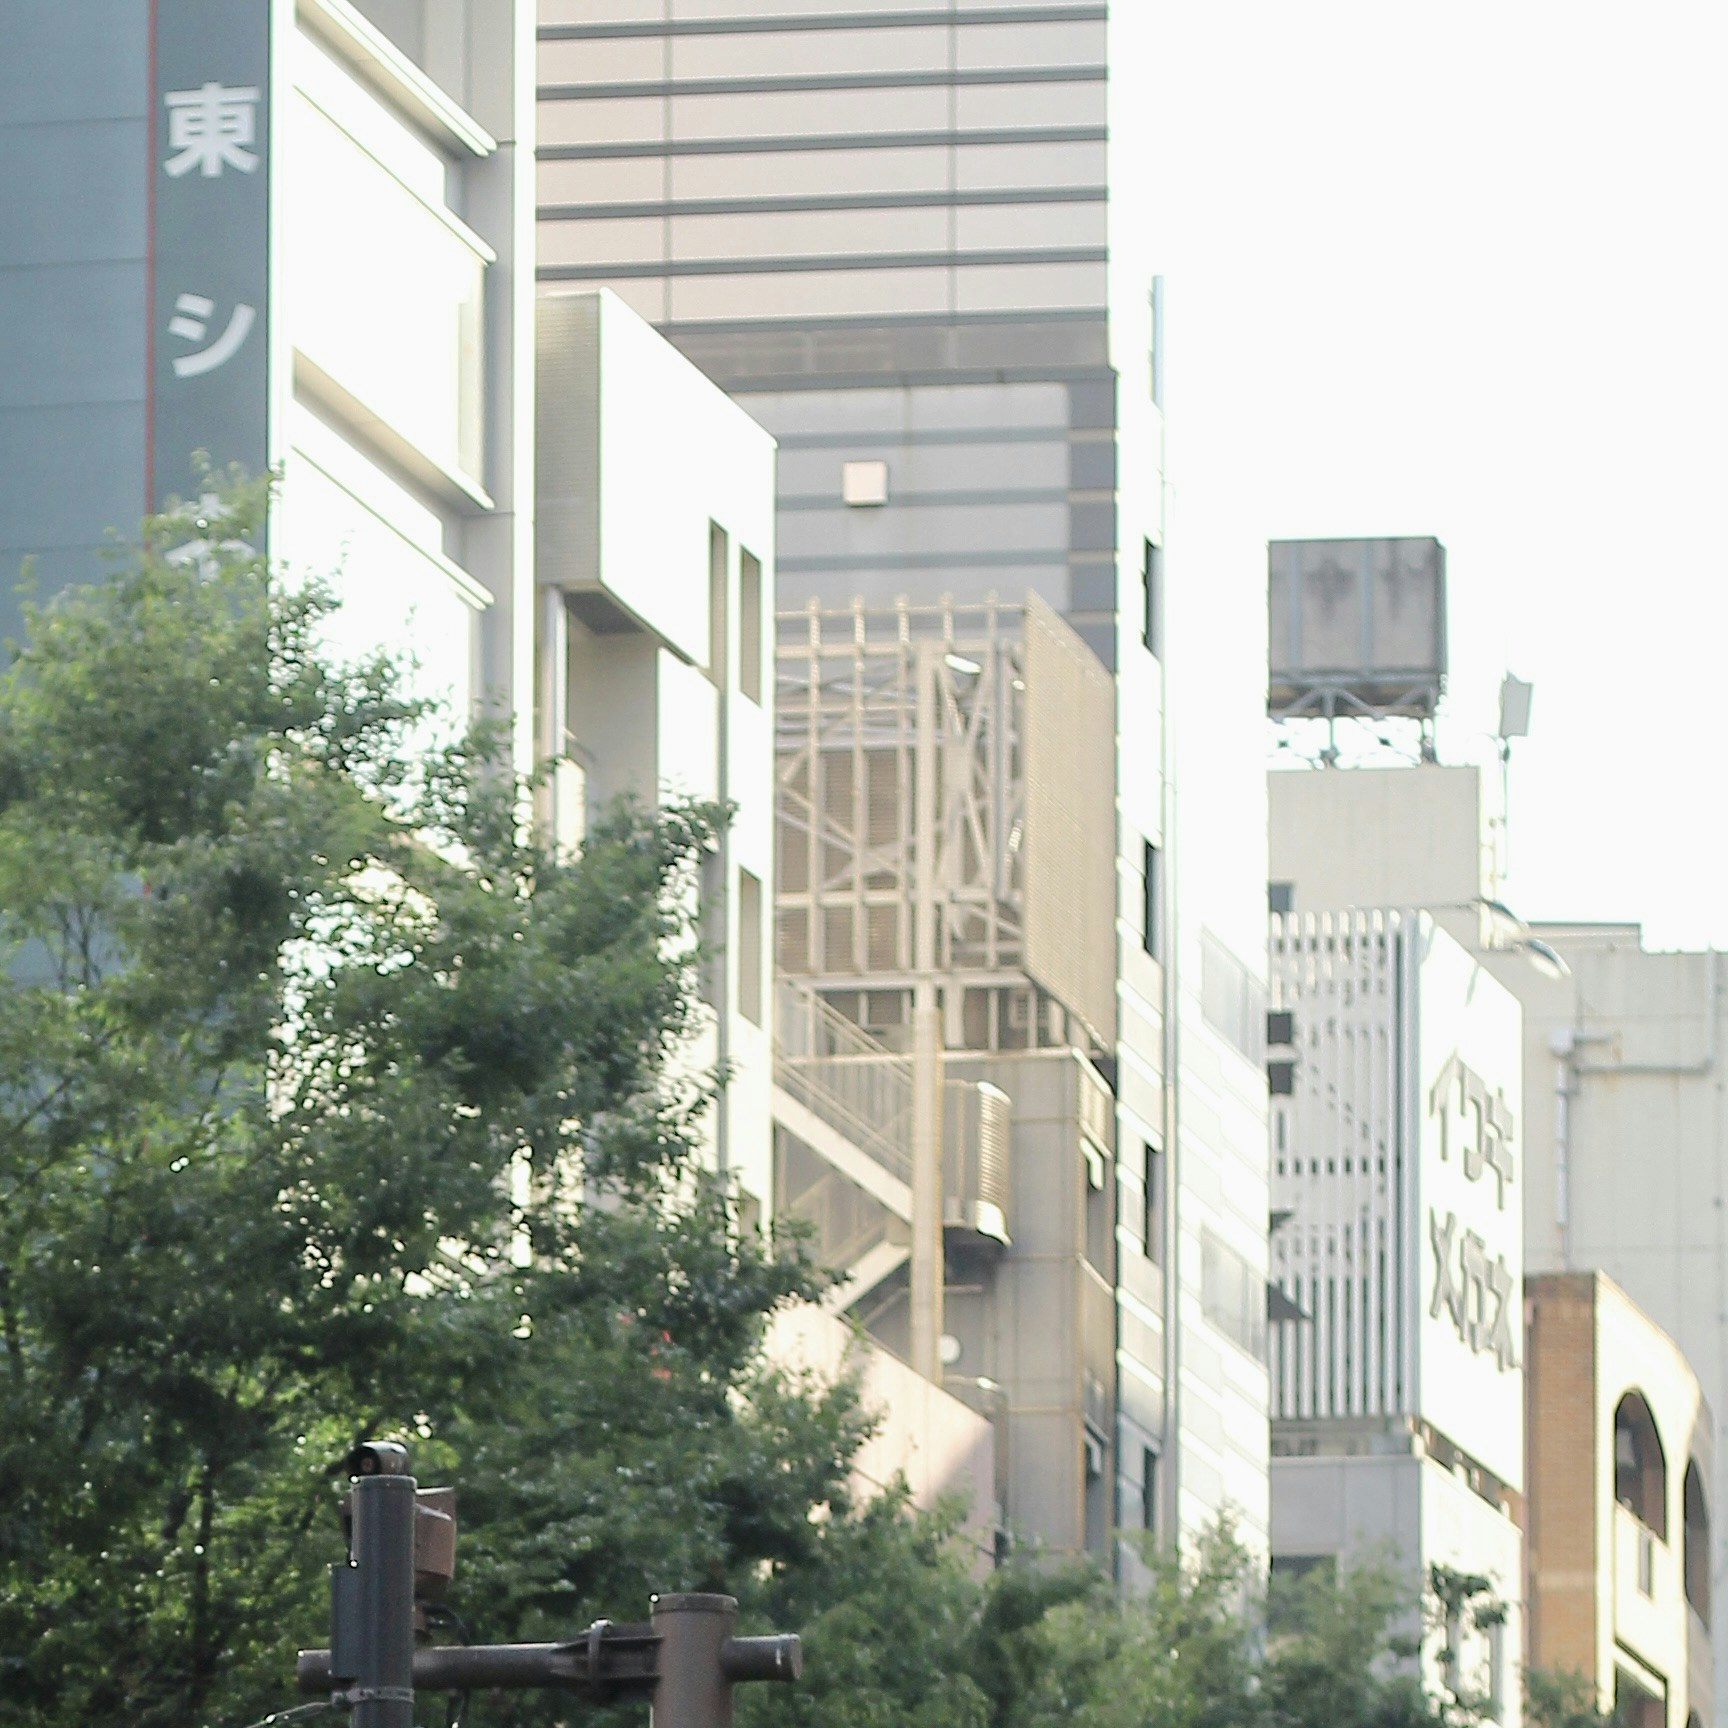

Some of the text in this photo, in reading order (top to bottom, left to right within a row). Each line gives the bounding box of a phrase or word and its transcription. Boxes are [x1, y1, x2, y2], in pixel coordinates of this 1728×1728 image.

[1429, 1047, 1514, 1211] イワキ
[1429, 1205, 1515, 1373] メガネ
